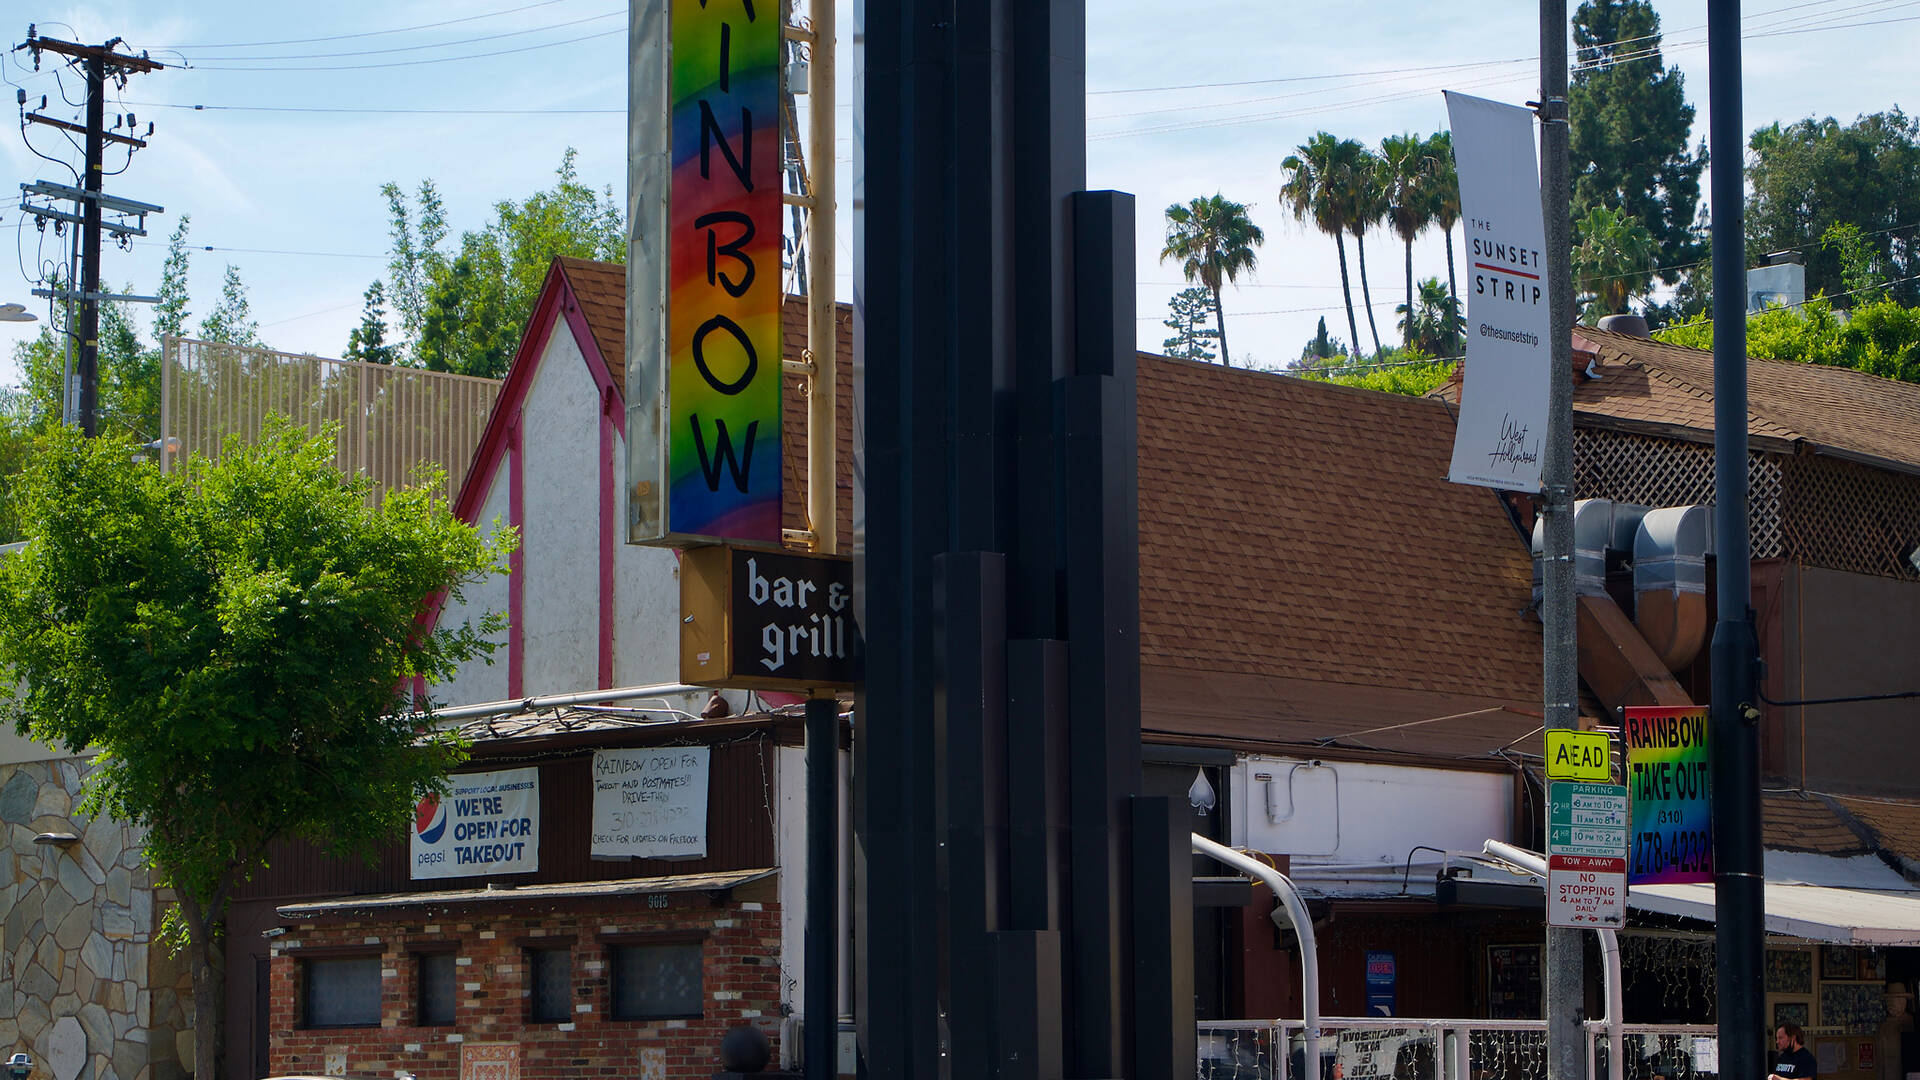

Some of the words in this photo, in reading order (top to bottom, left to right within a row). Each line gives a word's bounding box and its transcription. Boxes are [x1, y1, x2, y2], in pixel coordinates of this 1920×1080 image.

[1471, 219, 1490, 231] THE
[691, 0, 760, 494] INBOW
[1473, 238, 1538, 268] SUNSET
[1476, 275, 1541, 305] STRIP
[1480, 323, 1538, 347] @thesunsetstrip
[1501, 412, 1528, 452] West
[747, 557, 817, 610] bar
[829, 581, 849, 612] &
[760, 612, 846, 671] grill
[1628, 716, 1704, 748] RAINBOW
[596, 754, 647, 775] RAINBOW
[650, 756, 676, 771] OPEN
[681, 754, 698, 768] FOR
[1556, 743, 1603, 767] AEAD
[455, 787, 480, 796] SUPPORT
[498, 781, 535, 792] BUSINESSES
[622, 780, 639, 789] AND
[1572, 785, 1613, 795] PARKING
[1634, 762, 1671, 800] TAKE
[1676, 761, 1707, 800] OUT
[455, 797, 503, 817] WE'RE
[1552, 802, 1559, 814] 2
[1603, 801, 1612, 809] 10
[1576, 814, 1583, 823] 11
[1657, 810, 1683, 825] (310)
[454, 821, 498, 840] OPEN
[500, 818, 531, 838] FOR
[1552, 829, 1559, 841] 4
[1605, 834, 1611, 842] 2
[454, 842, 525, 865] TAKEOUT
[1563, 857, 1580, 865] TOW
[1588, 859, 1613, 867] AWAY
[1635, 831, 1709, 874] 278-4232
[1580, 873, 1596, 883] NO
[1559, 884, 1615, 896] STOPPING
[1595, 897, 1600, 905] 7
